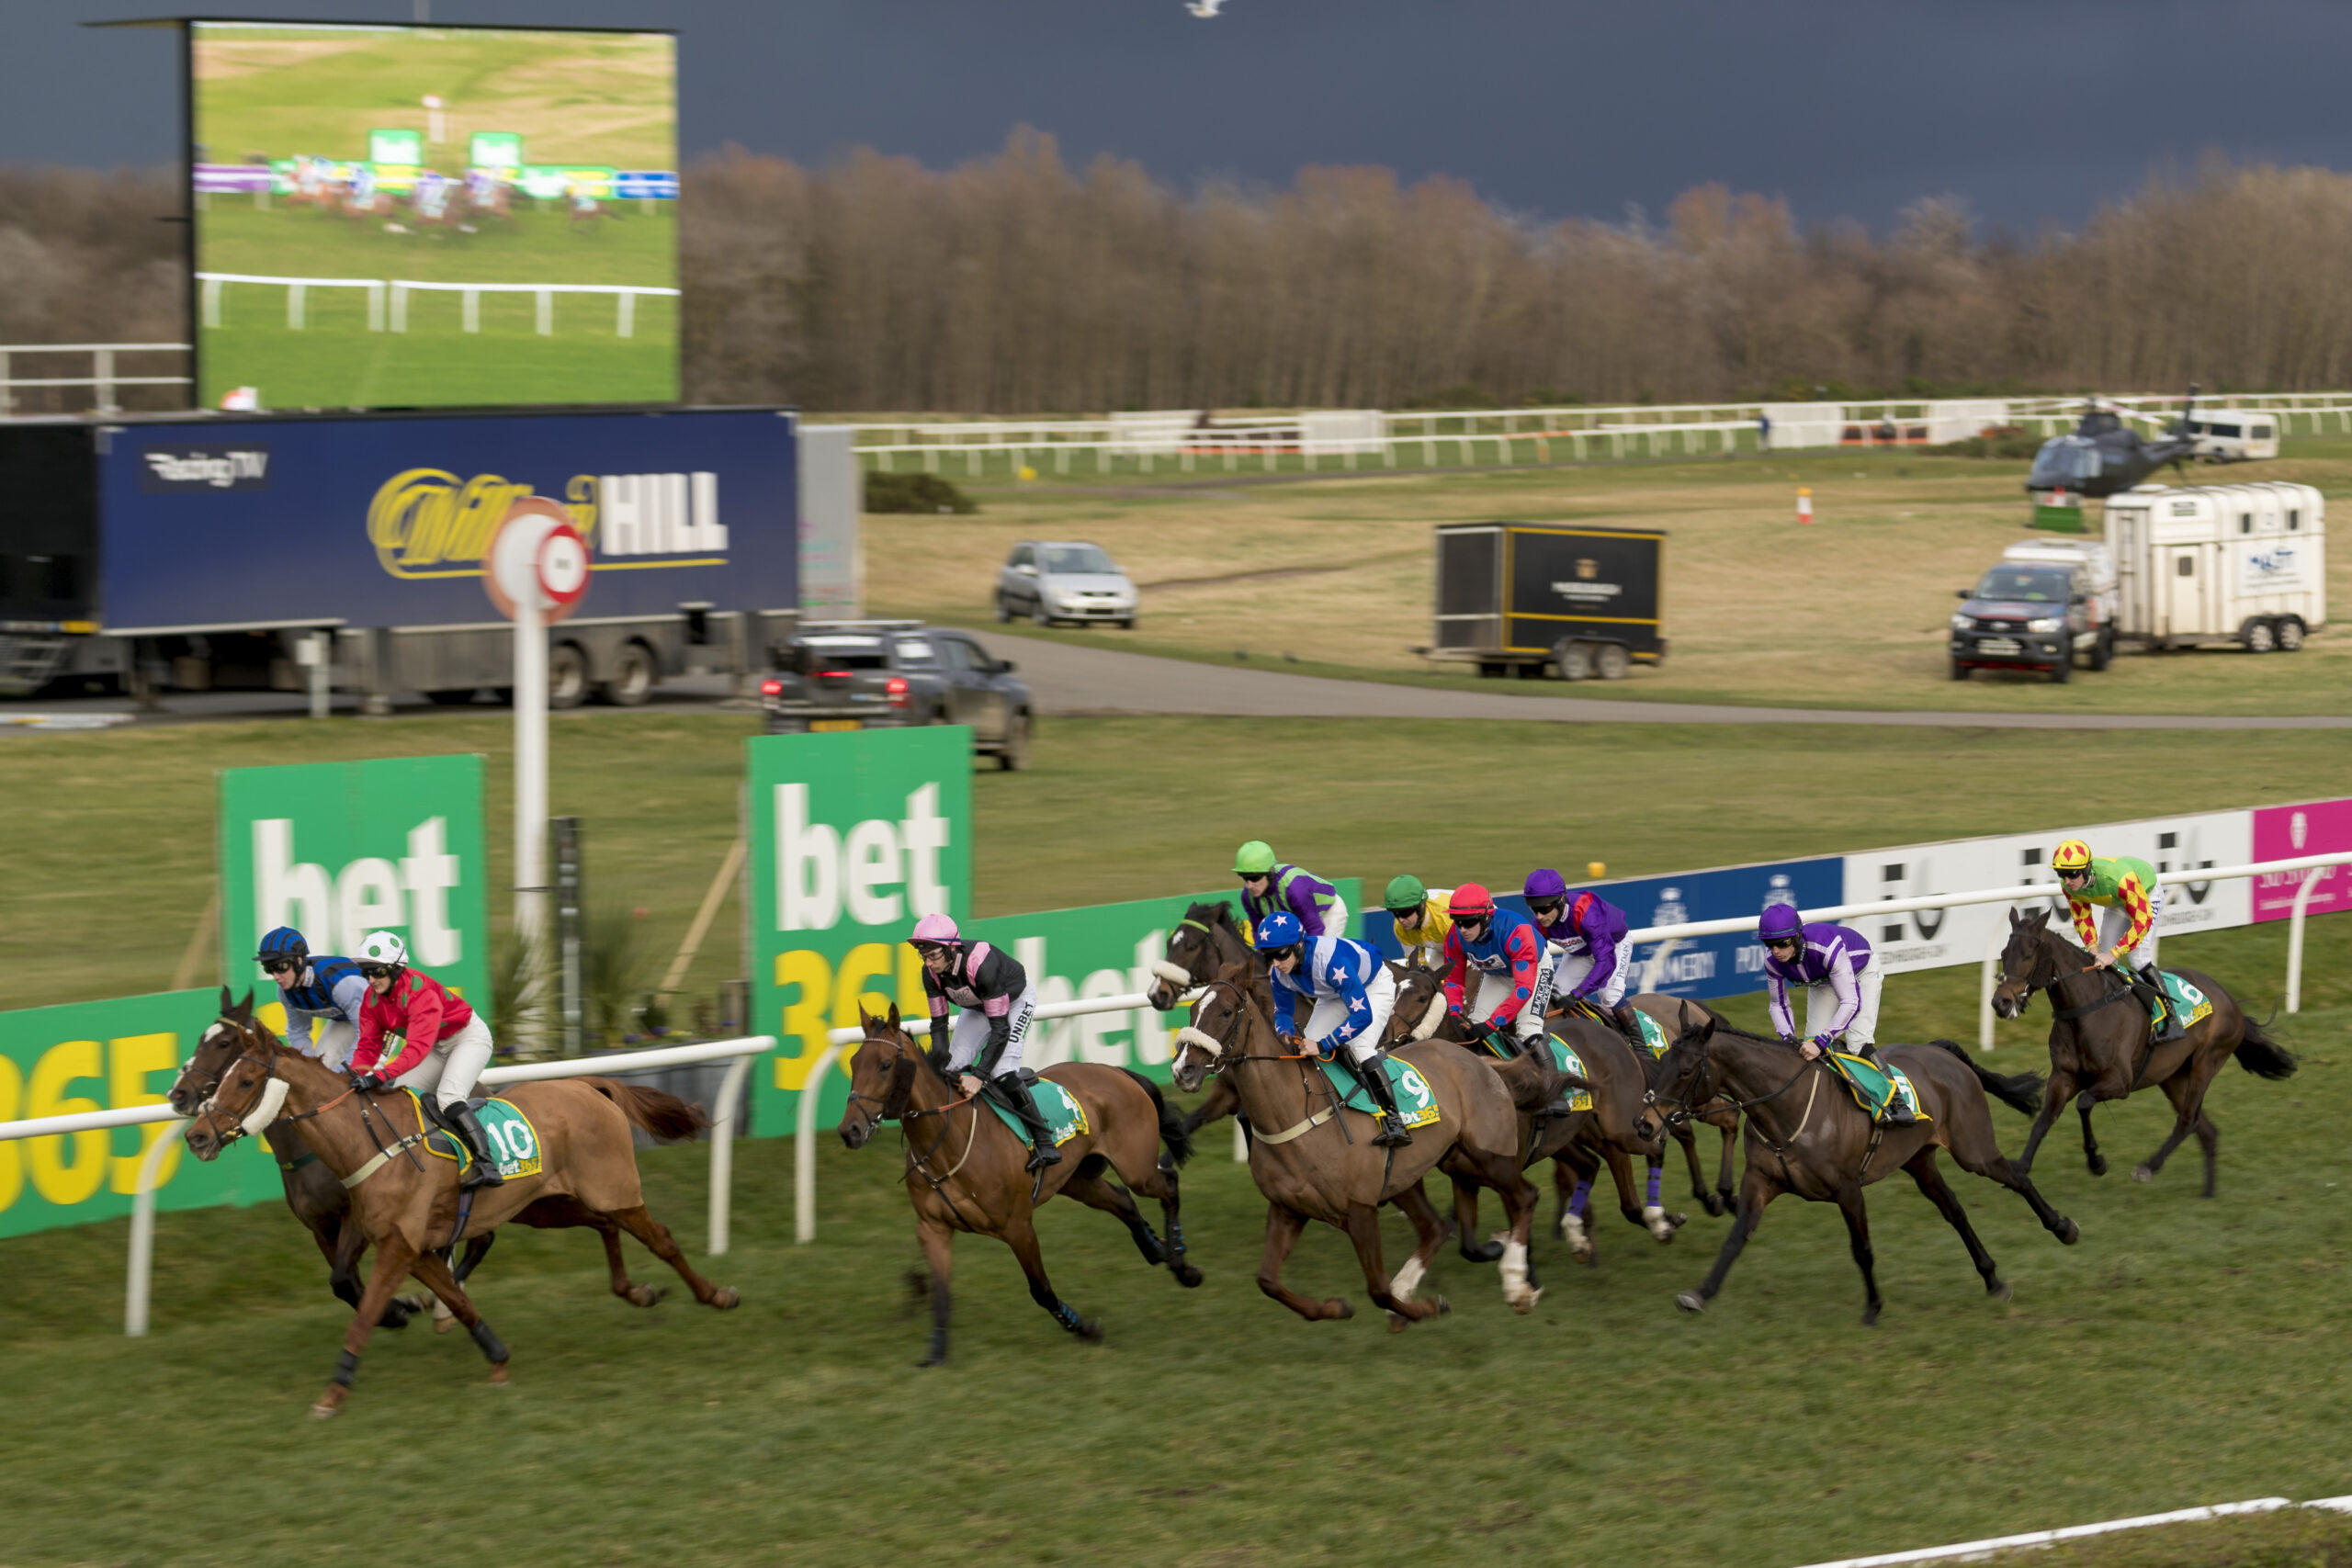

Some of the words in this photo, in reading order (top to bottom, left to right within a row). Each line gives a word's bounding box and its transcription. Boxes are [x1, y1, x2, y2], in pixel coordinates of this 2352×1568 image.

[599, 472, 729, 555] HILL
[774, 781, 950, 932] bet
[251, 816, 460, 980] bet
[1014, 930, 1176, 1075] bet
[2177, 978, 2203, 1006] 6
[1009, 1000, 1034, 1043] UNIBET
[1402, 1070, 1429, 1109] 9
[487, 1119, 534, 1161] 10
[498, 1157, 537, 1176] bet365
